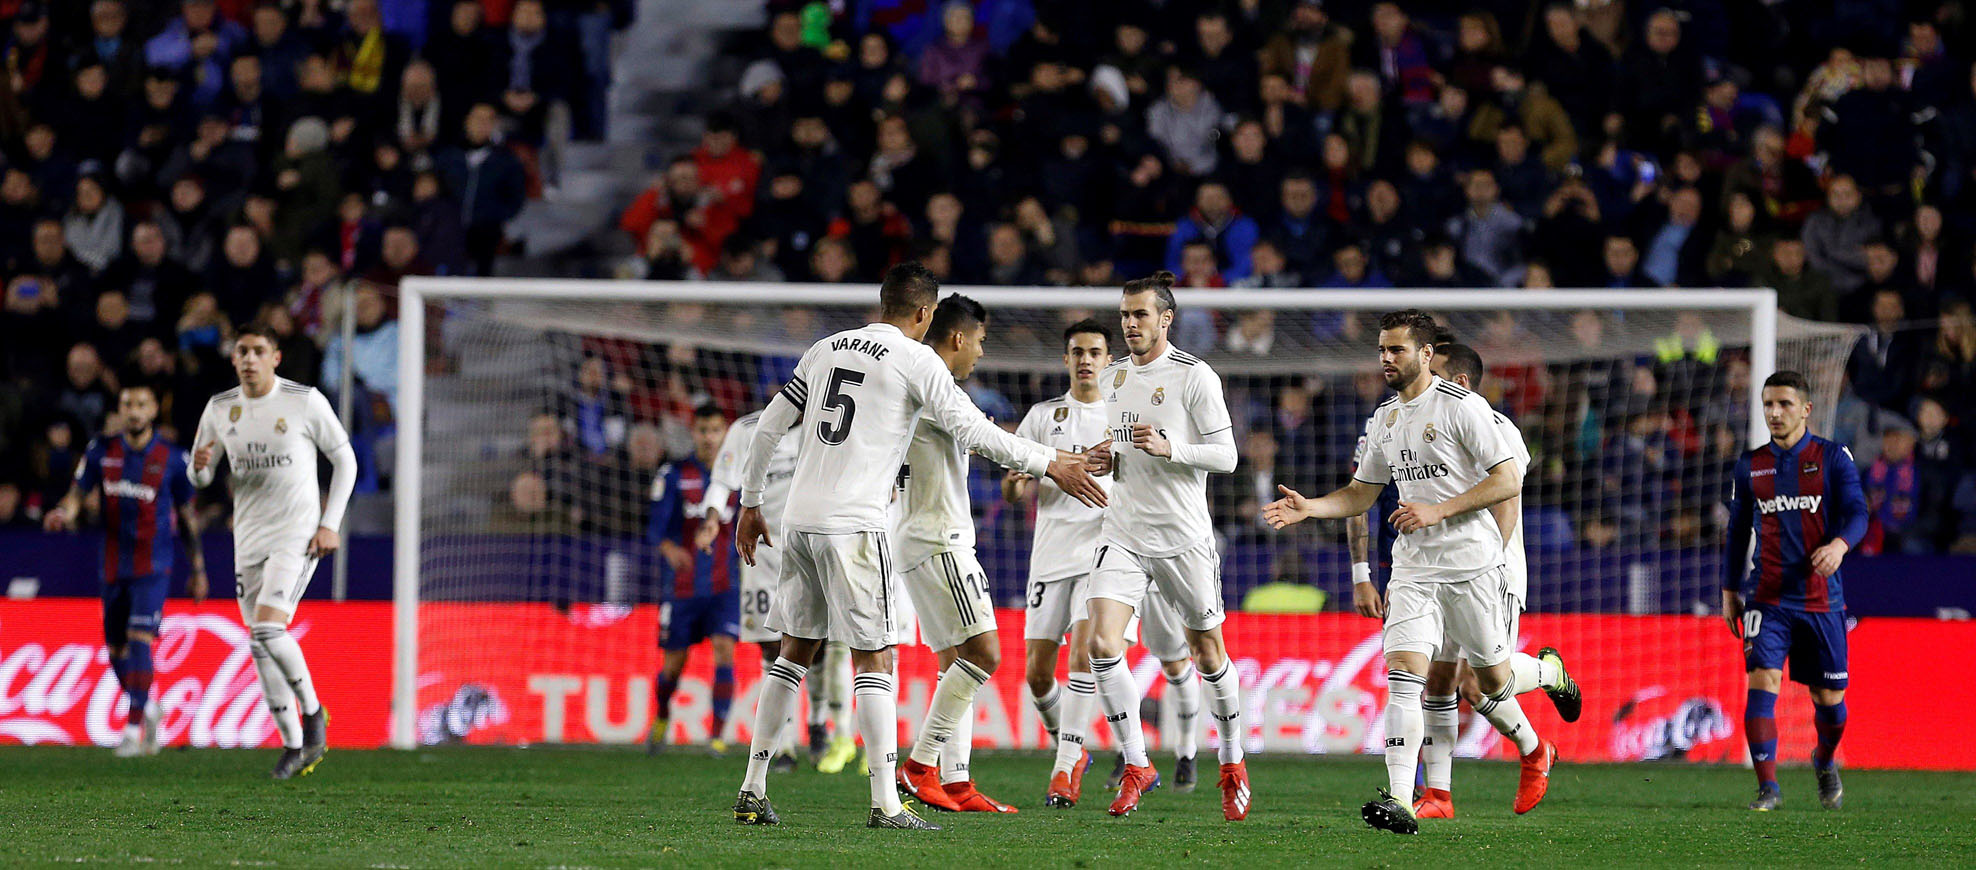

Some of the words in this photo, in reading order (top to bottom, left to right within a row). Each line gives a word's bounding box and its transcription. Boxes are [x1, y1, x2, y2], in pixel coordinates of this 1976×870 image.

[831, 338, 889, 361] VARANE
[817, 366, 866, 446] 5
[1121, 411, 1139, 424] Fly
[1400, 449, 1418, 463] Fly
[1389, 462, 1449, 482] Emirates
[1758, 495, 1822, 515] betway
[745, 589, 769, 614] 28
[1743, 609, 1763, 639] 10
